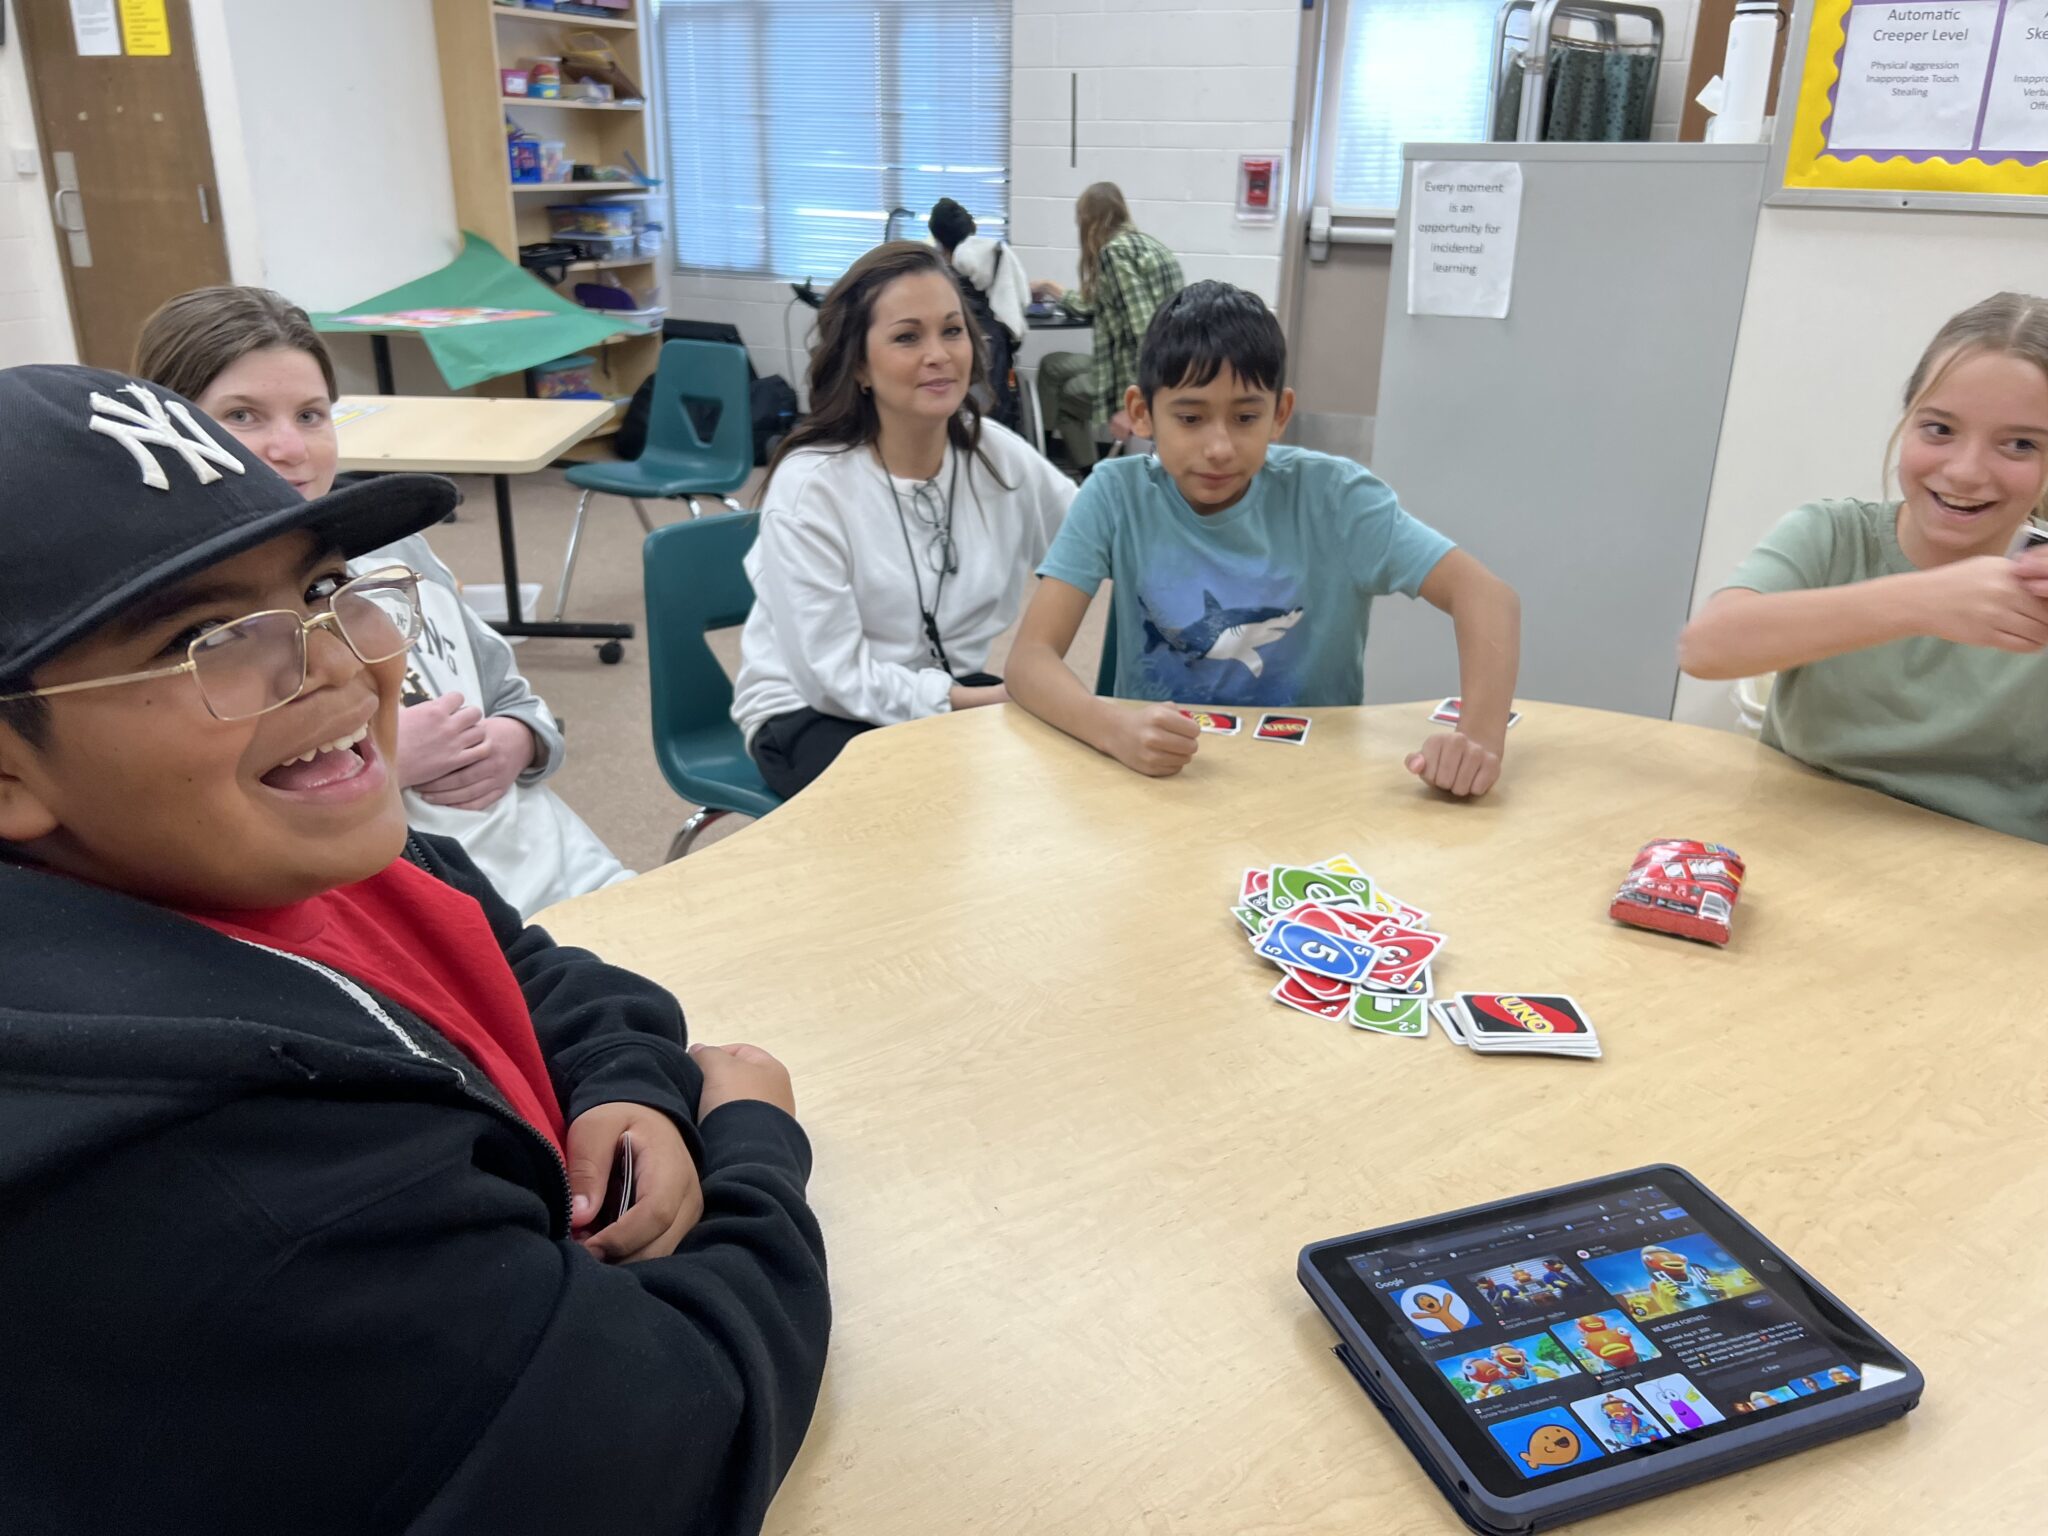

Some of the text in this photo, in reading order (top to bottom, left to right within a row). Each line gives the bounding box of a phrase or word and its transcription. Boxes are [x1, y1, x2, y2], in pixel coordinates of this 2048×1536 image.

[1887, 8, 1961, 21] Automatic
[1873, 28, 1969, 43] Creeper Level
[1870, 61, 1960, 71] Physical aggression
[1865, 74, 1960, 84] Inappropriate Touch
[1890, 88, 1929, 98] Stealing
[1424, 181, 1505, 194] Every moment
[1449, 203, 1475, 213] is an
[1417, 223, 1502, 235] opportunity for
[1430, 242, 1484, 254] incidental
[1432, 262, 1478, 276] learning
[89, 382, 246, 490] NY
[1264, 944, 1283, 956] 5
[1301, 940, 1340, 964] 5
[1352, 945, 1372, 957] 5
[1379, 944, 1412, 966] 3
[1495, 995, 1554, 1034] UNO
[1375, 1278, 1405, 1289] Google
